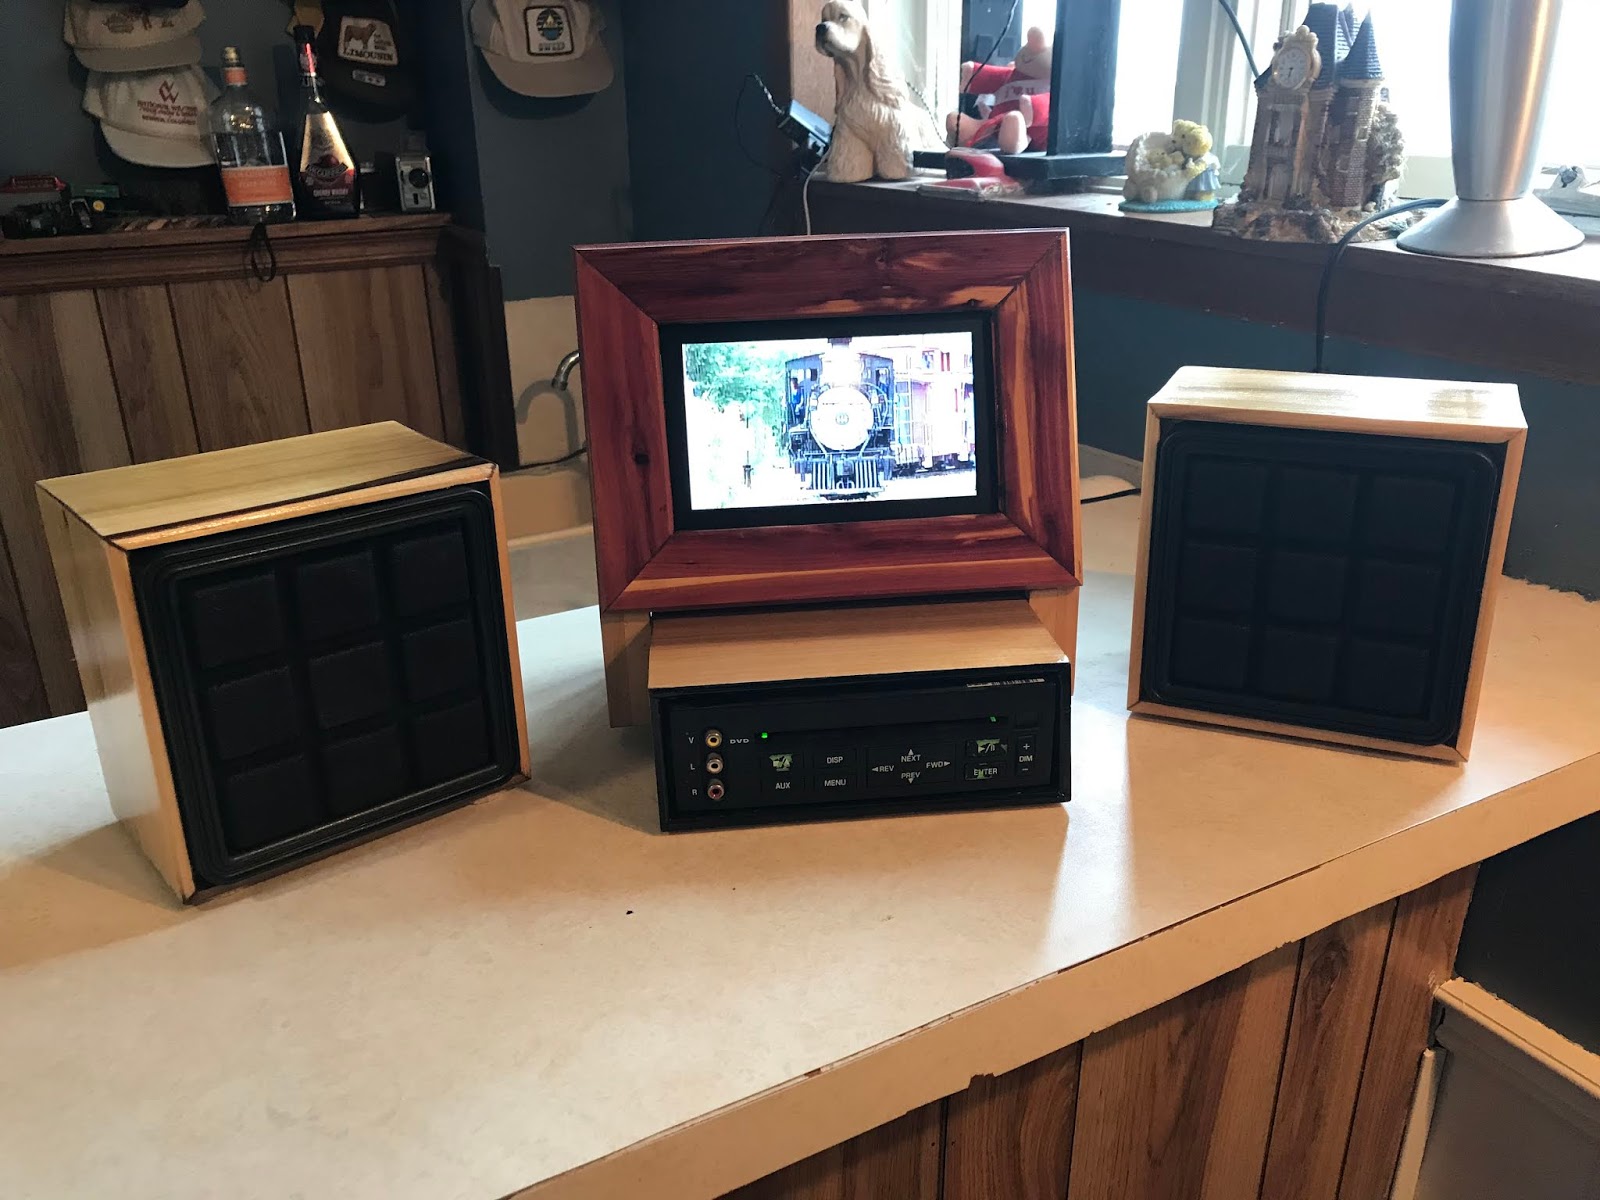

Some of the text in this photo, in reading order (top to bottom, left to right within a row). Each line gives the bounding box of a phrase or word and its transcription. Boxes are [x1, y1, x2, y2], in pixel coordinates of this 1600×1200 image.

[826, 756, 844, 764] DISP
[901, 754, 921, 763] NEXT
[926, 761, 944, 769] FWD
[901, 771, 921, 779] PREV
[973, 767, 998, 776] ENTER
[775, 782, 791, 790] AUX
[824, 779, 847, 787] MENU
